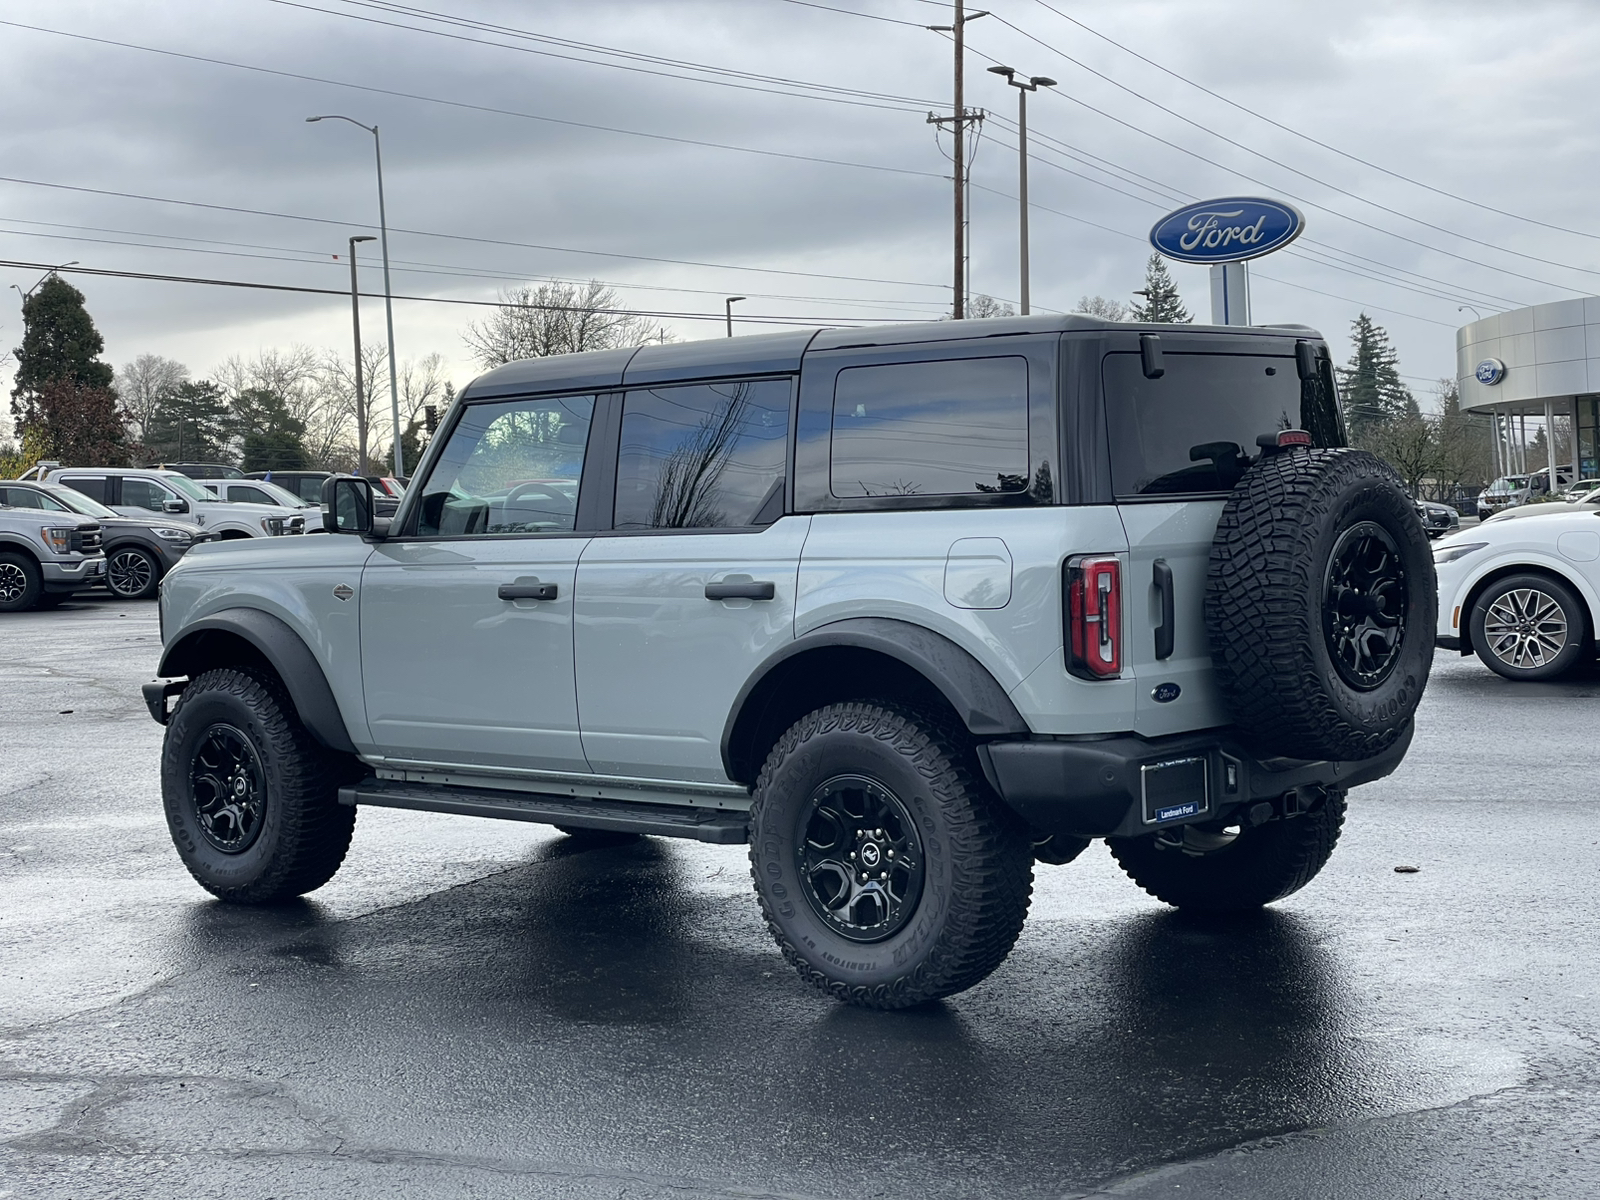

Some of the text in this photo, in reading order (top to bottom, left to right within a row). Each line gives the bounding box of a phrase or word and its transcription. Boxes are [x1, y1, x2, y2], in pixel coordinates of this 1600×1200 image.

[1180, 210, 1266, 250] Ford
[1160, 804, 1194, 819] Landmark Ford
[763, 753, 817, 919] GOODYEAR
[801, 935, 877, 971] TERRITORY MT
